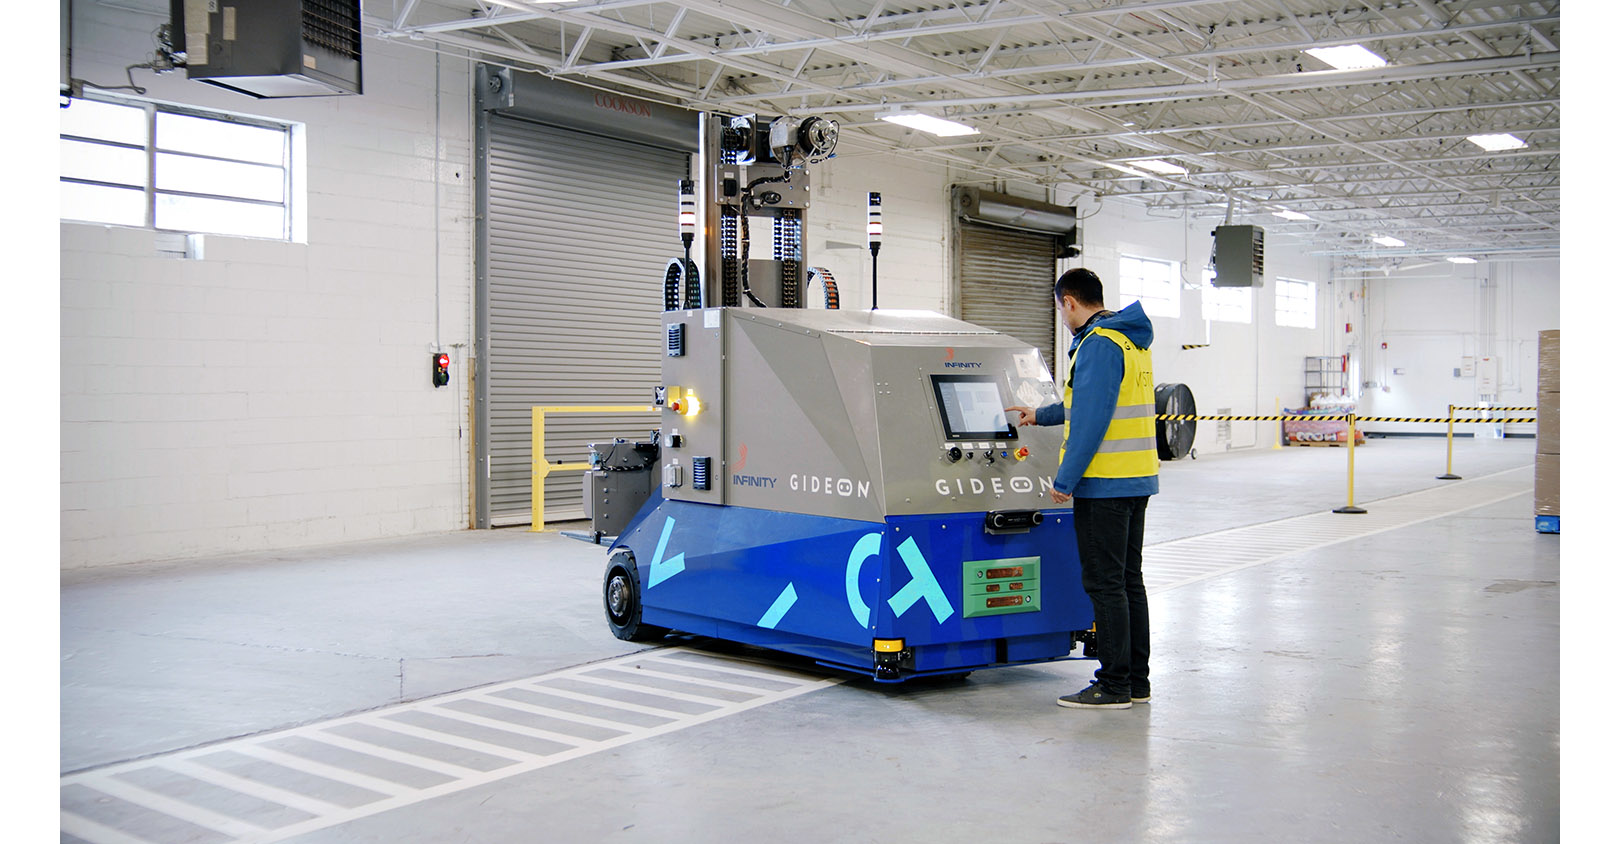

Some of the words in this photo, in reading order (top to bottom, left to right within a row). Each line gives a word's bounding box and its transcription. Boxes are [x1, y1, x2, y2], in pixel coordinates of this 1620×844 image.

[594, 93, 652, 118] COOKSON
[944, 361, 983, 369] INFINITY
[733, 474, 777, 489] INFINITY
[789, 473, 870, 499] GIDEON
[935, 475, 1054, 496] GIDEON
